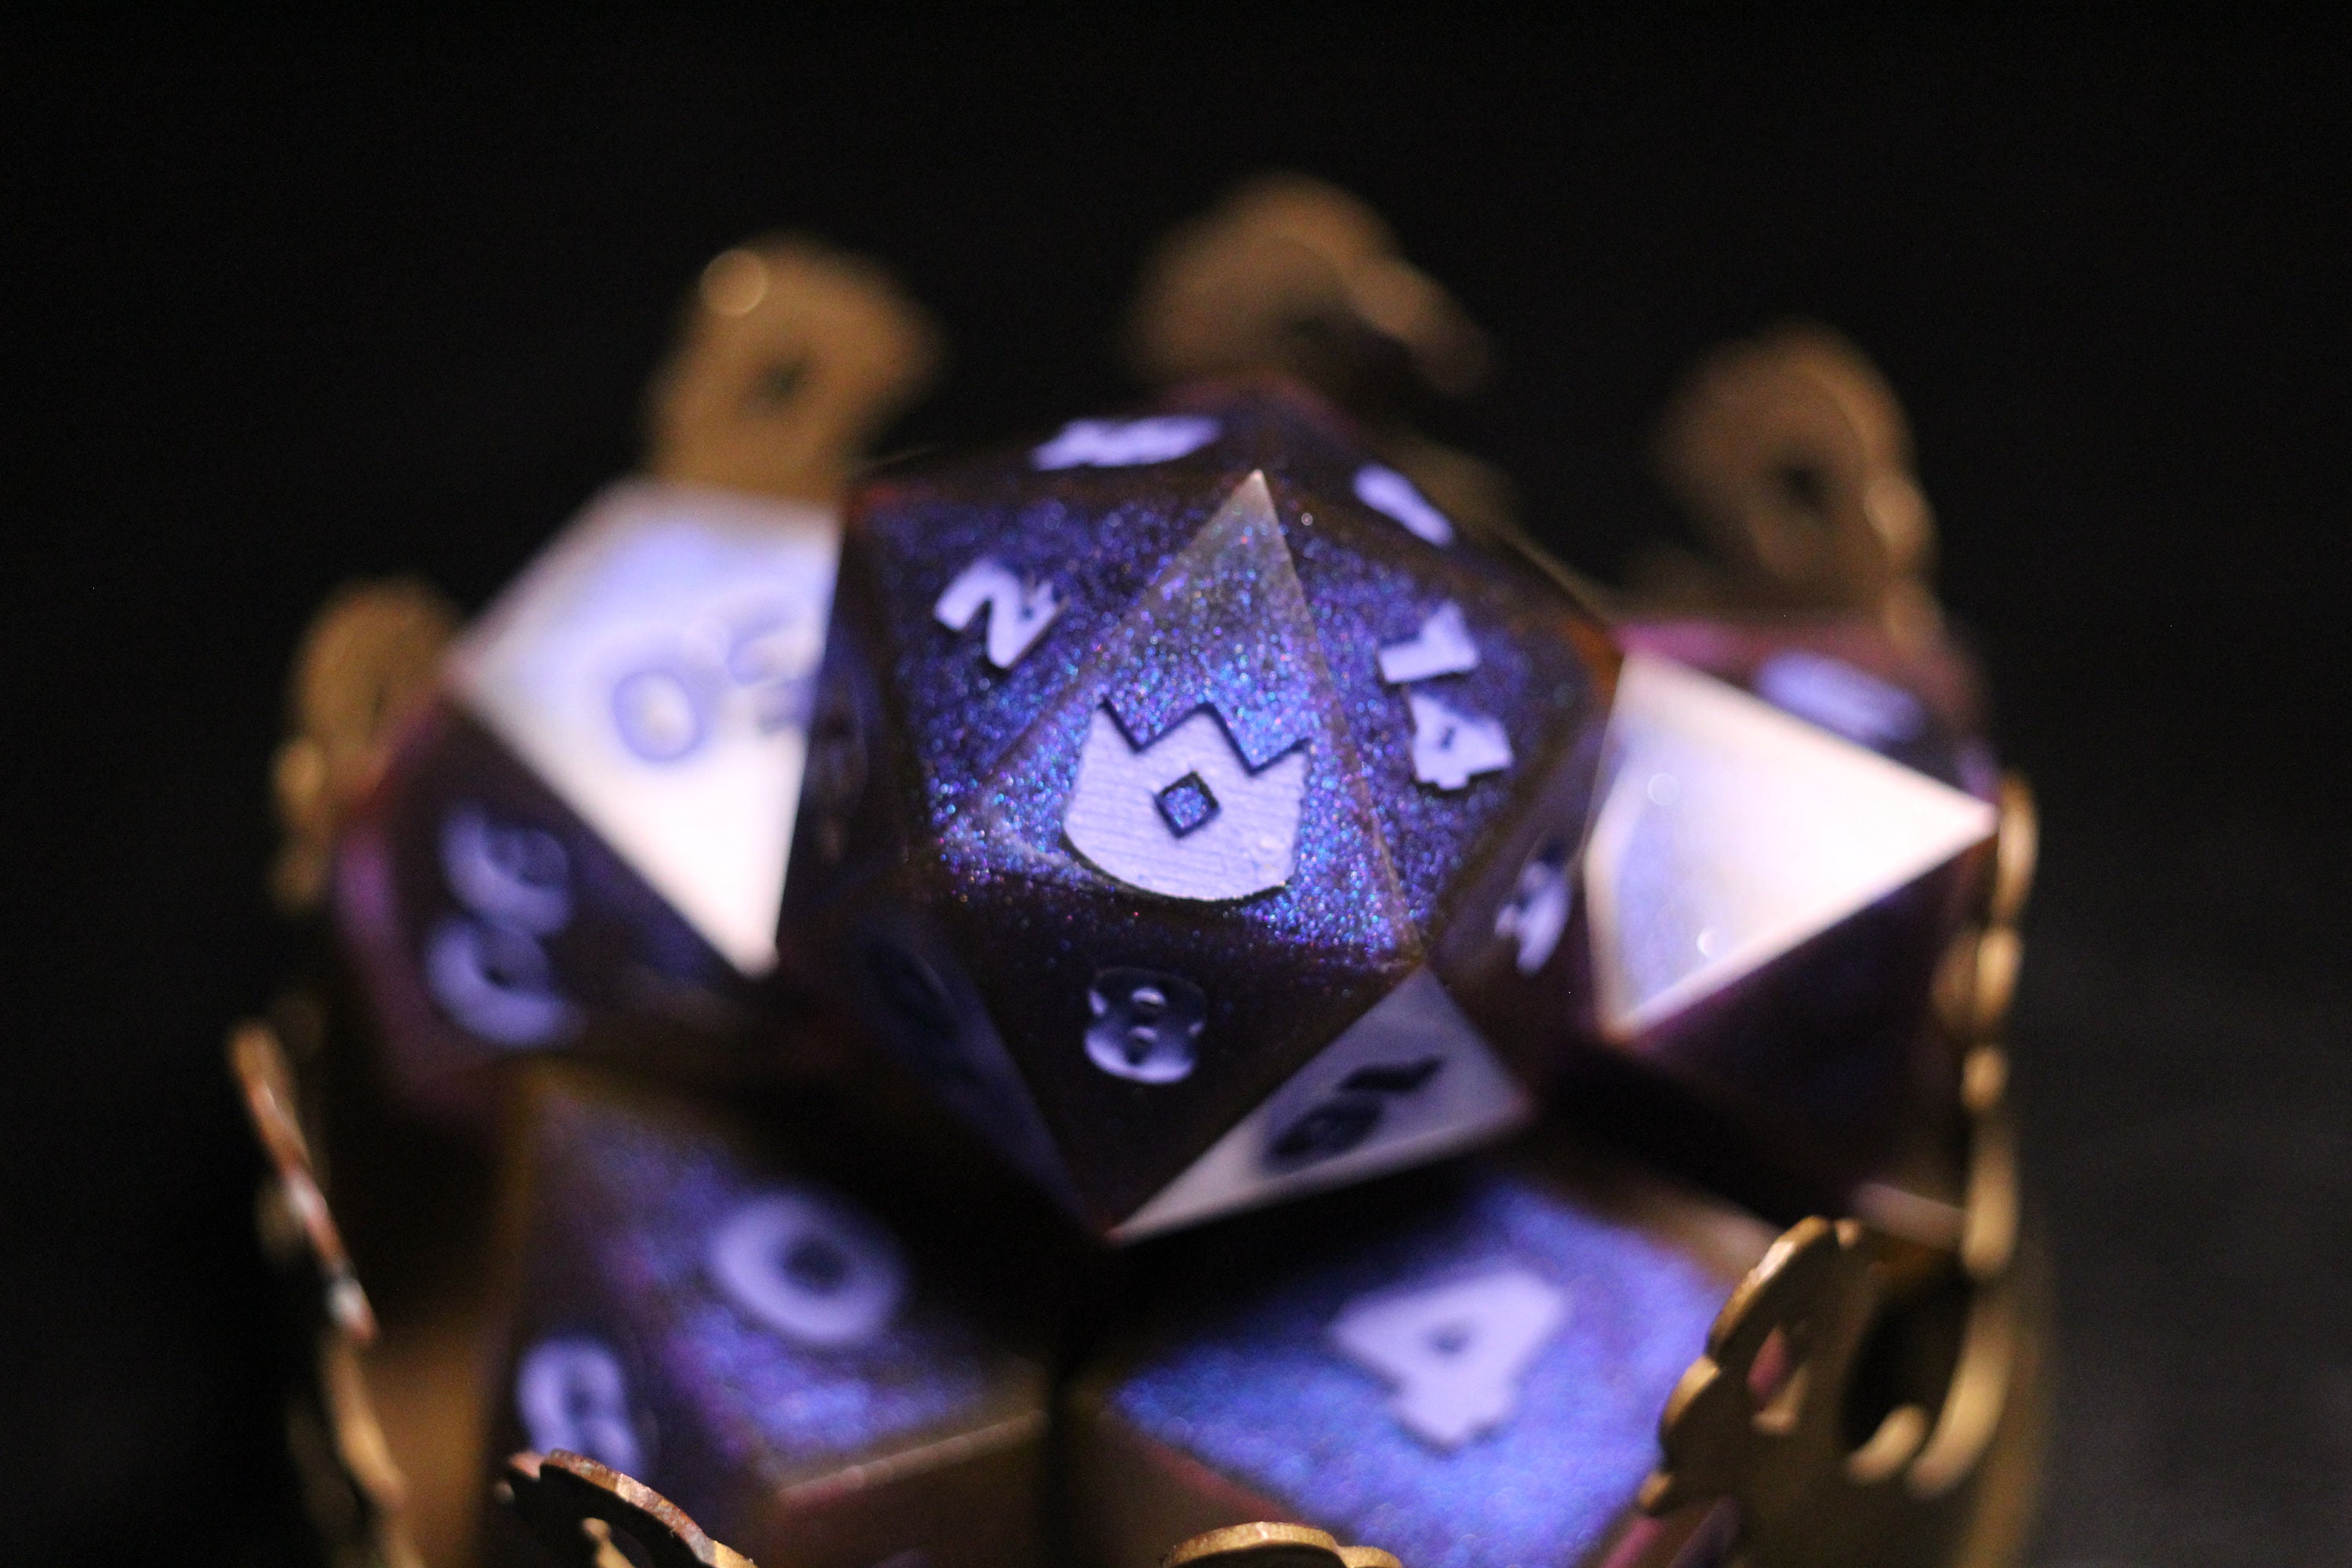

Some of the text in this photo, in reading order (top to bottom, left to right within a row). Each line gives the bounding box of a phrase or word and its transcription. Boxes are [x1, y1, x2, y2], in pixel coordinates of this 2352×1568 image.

[935, 558, 1068, 670] 2
[1378, 599, 1513, 790] 14
[1082, 966, 1207, 1084] 8
[1329, 1265, 1565, 1449] 4
